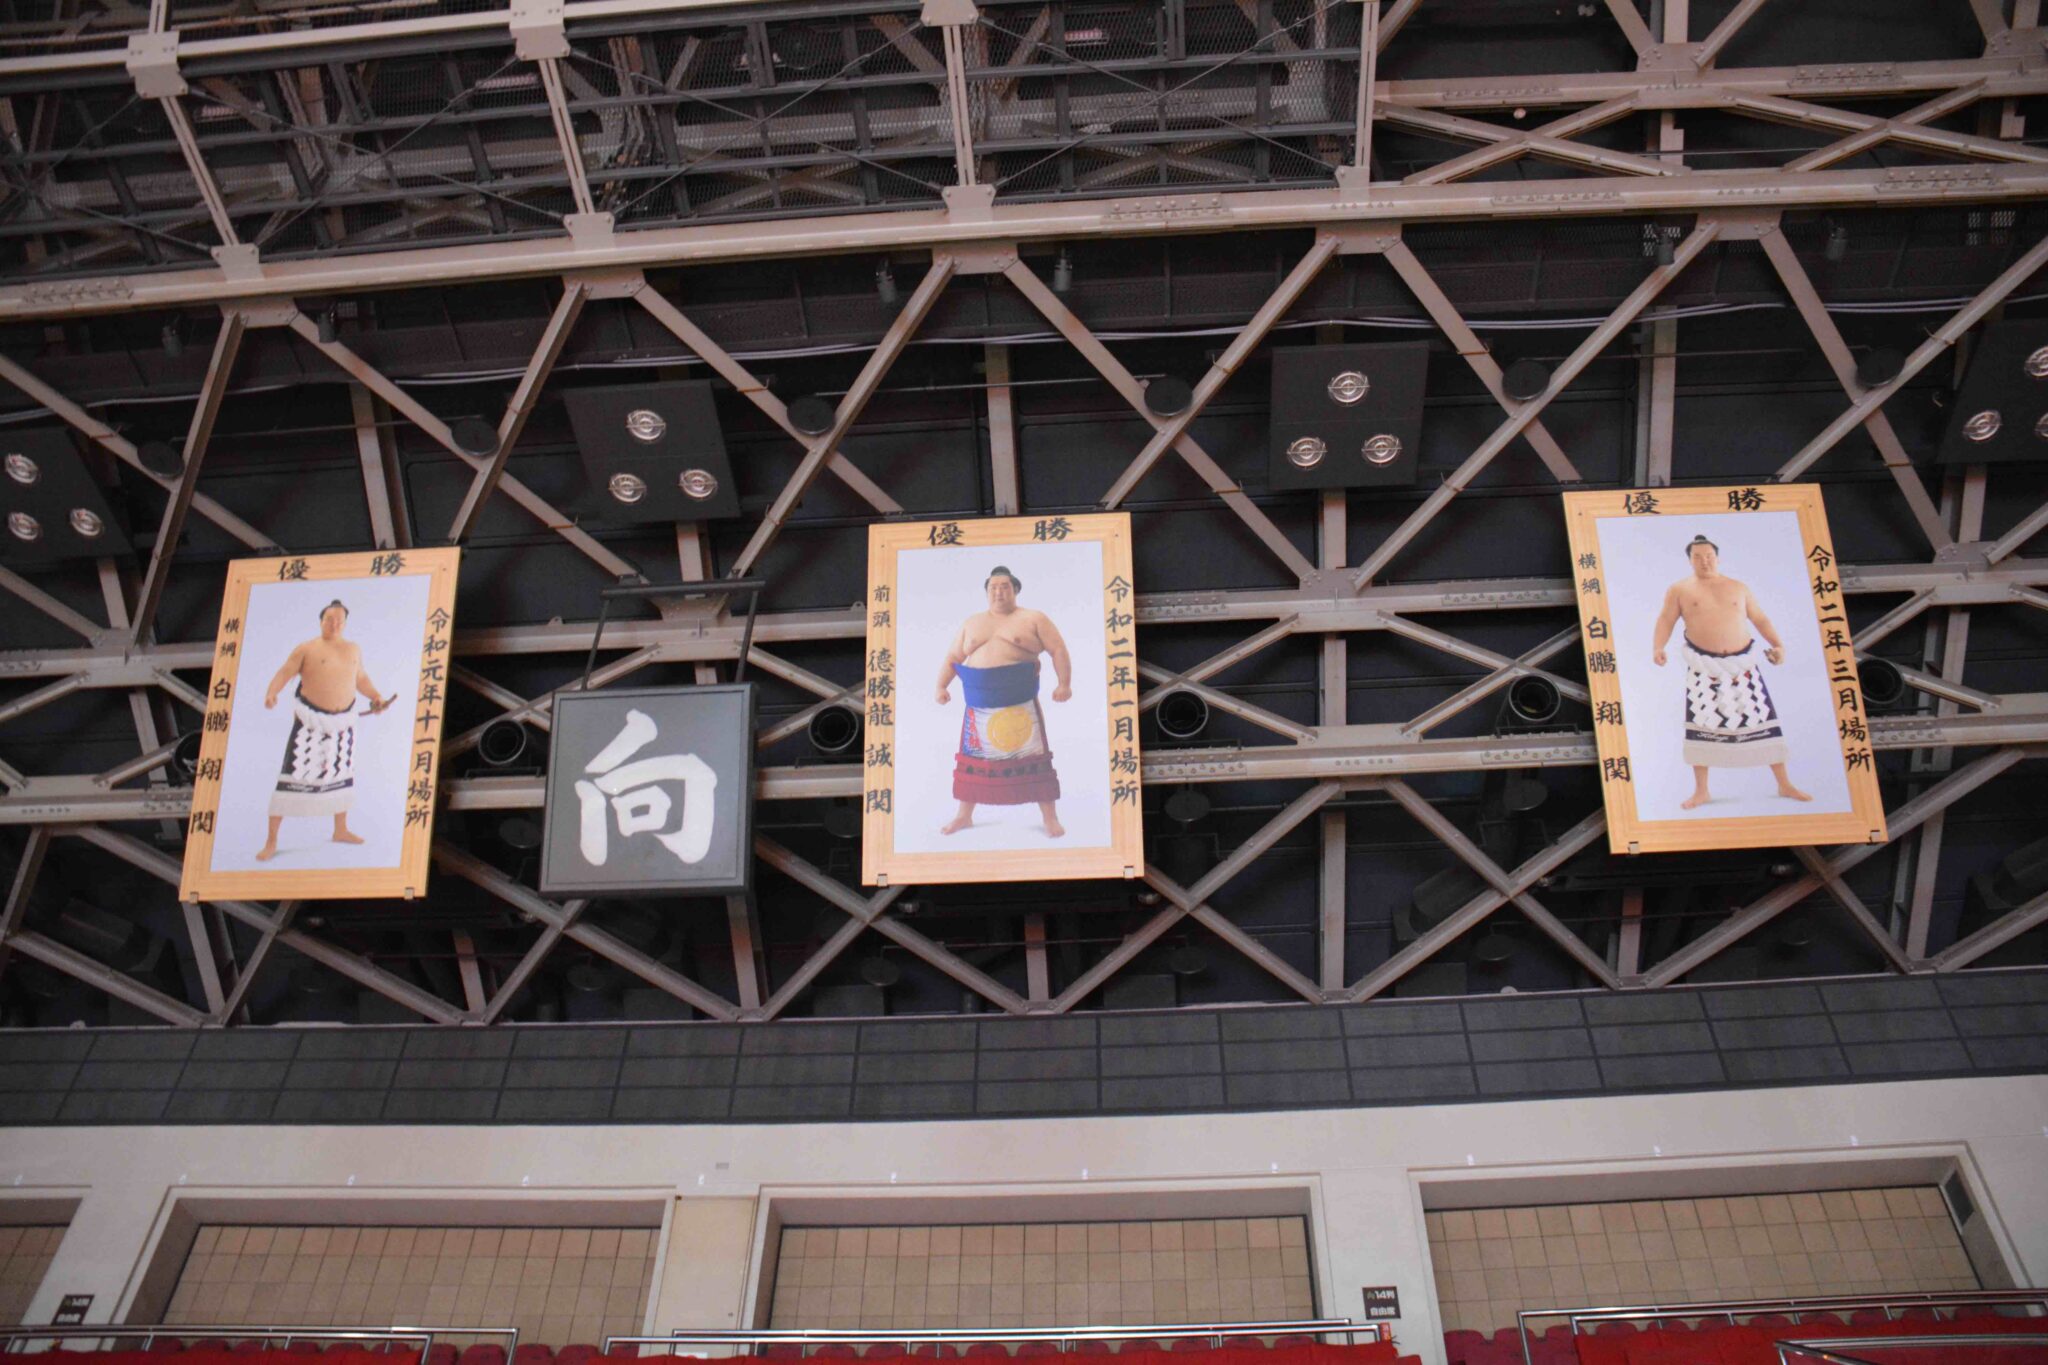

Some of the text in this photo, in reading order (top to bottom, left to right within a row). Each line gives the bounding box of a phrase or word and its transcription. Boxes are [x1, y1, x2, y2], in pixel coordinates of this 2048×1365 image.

[928, 518, 1073, 545] 優勝
[1623, 488, 1766, 514] 優勝
[278, 553, 406, 581] 優勝
[405, 607, 451, 831] 令和元年十一月場所
[1104, 575, 1140, 807] 令和二年一月場所
[1807, 544, 1871, 773] 令和二年三月場所
